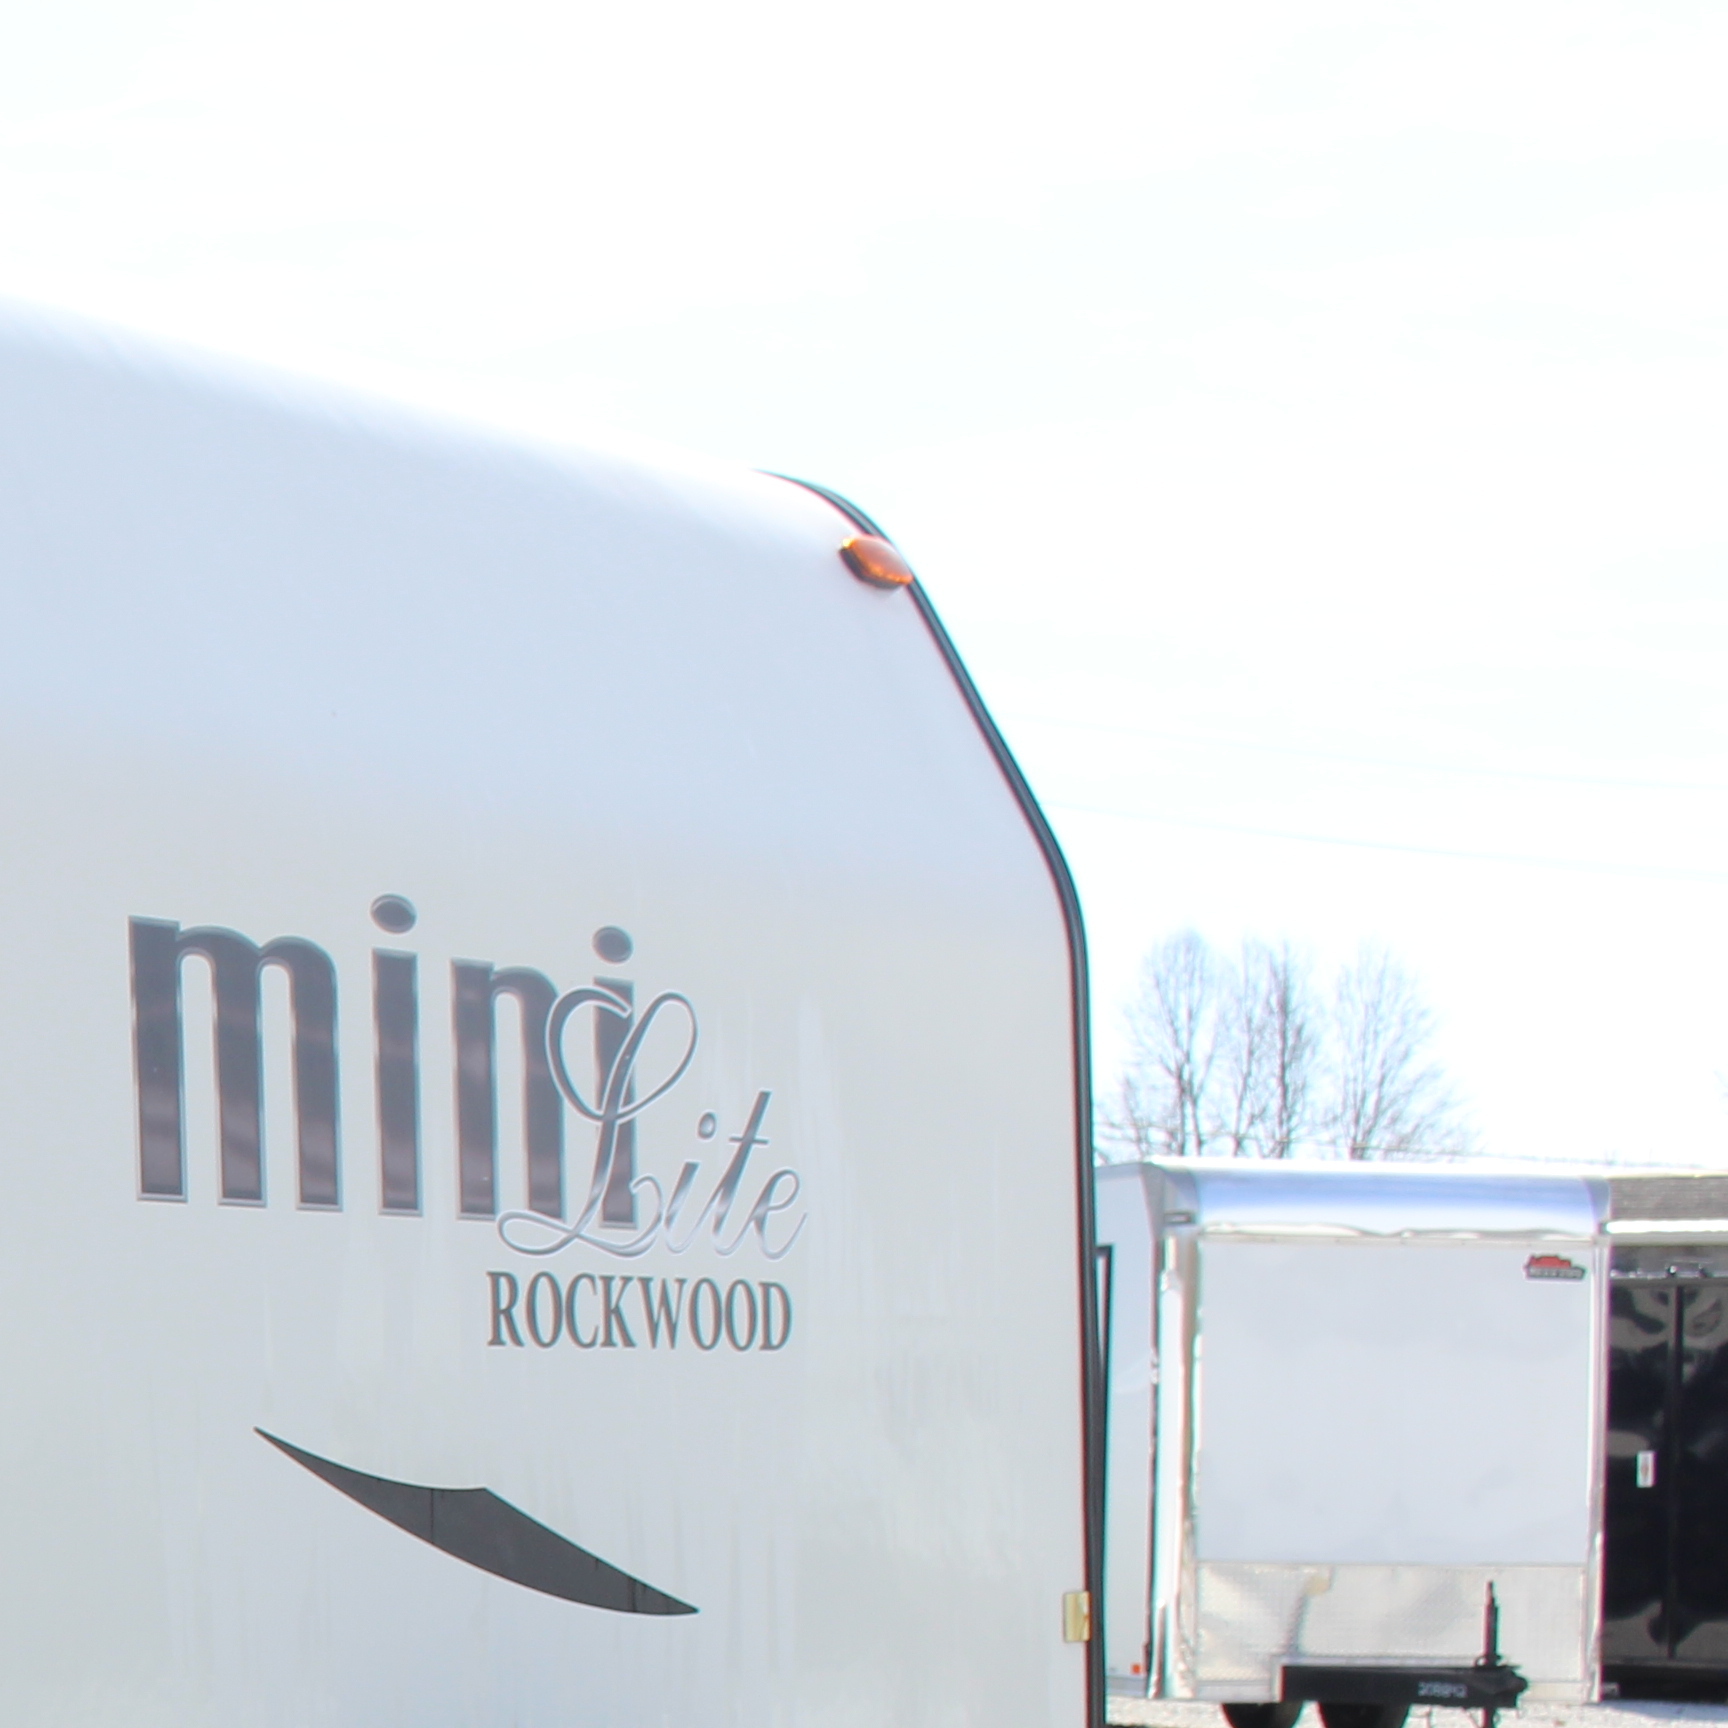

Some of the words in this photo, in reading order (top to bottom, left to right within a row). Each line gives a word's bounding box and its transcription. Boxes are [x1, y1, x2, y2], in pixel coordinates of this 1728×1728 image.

[128, 893, 639, 1229] mini
[496, 987, 808, 1261] Lite
[486, 1270, 793, 1353] ROCKWOOD
